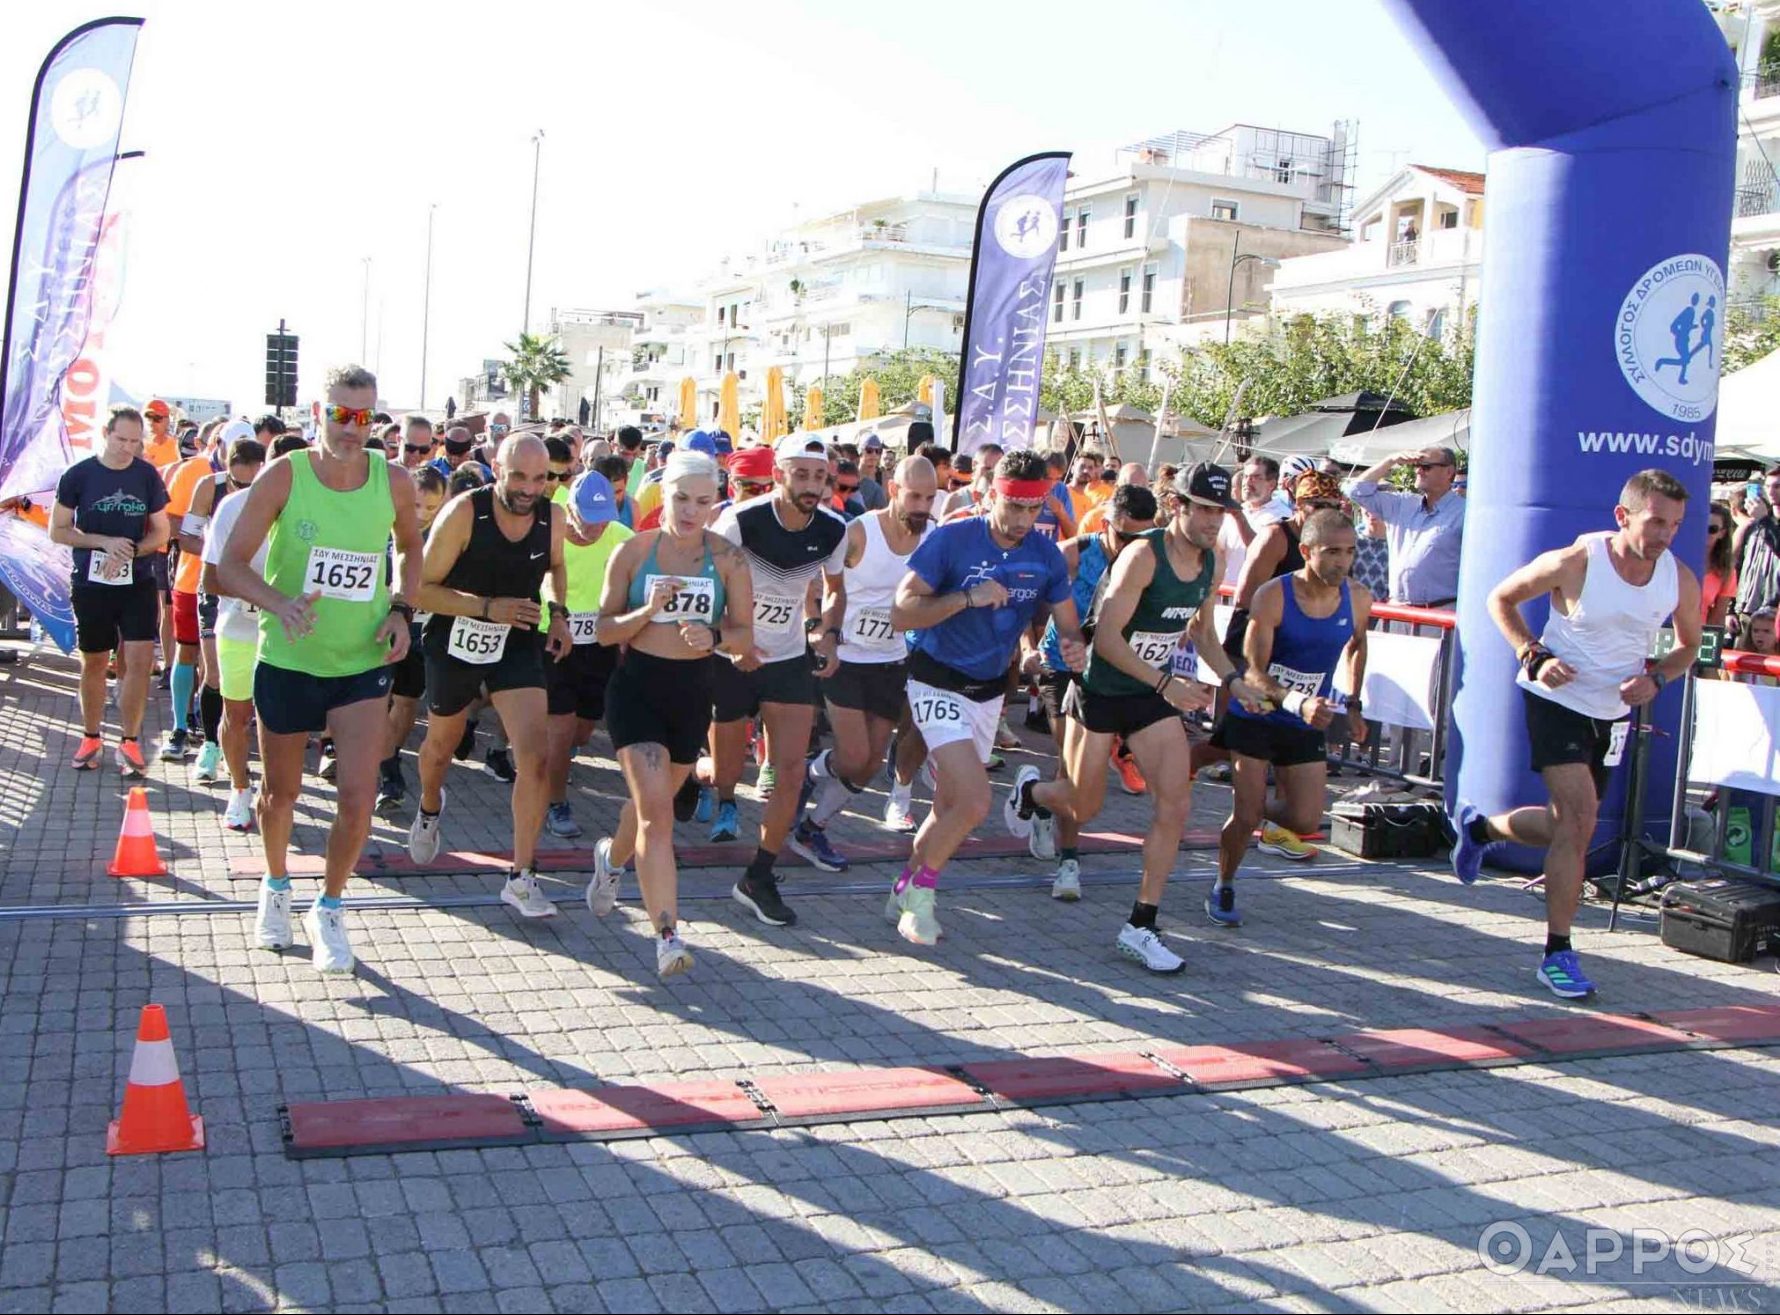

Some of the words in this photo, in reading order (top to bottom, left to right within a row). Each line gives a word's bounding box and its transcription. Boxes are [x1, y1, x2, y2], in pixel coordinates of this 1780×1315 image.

[1619, 300, 1646, 384] ΣΥΛΛΟΓΟΣ
[1636, 259, 1702, 301] ΔΡΟΜΕΩΝ
[1000, 277, 1046, 450] ΣΣΗΝΙΑΣ
[1671, 402, 1702, 421] 1985
[313, 549, 329, 559] ΣΔΥ
[331, 552, 378, 564] ΜΕΣΣΗΝΙΑΣ
[312, 561, 372, 589] 1652
[454, 628, 501, 654] 1653
[1134, 641, 1176, 662] 162
[914, 700, 960, 723] 1765
